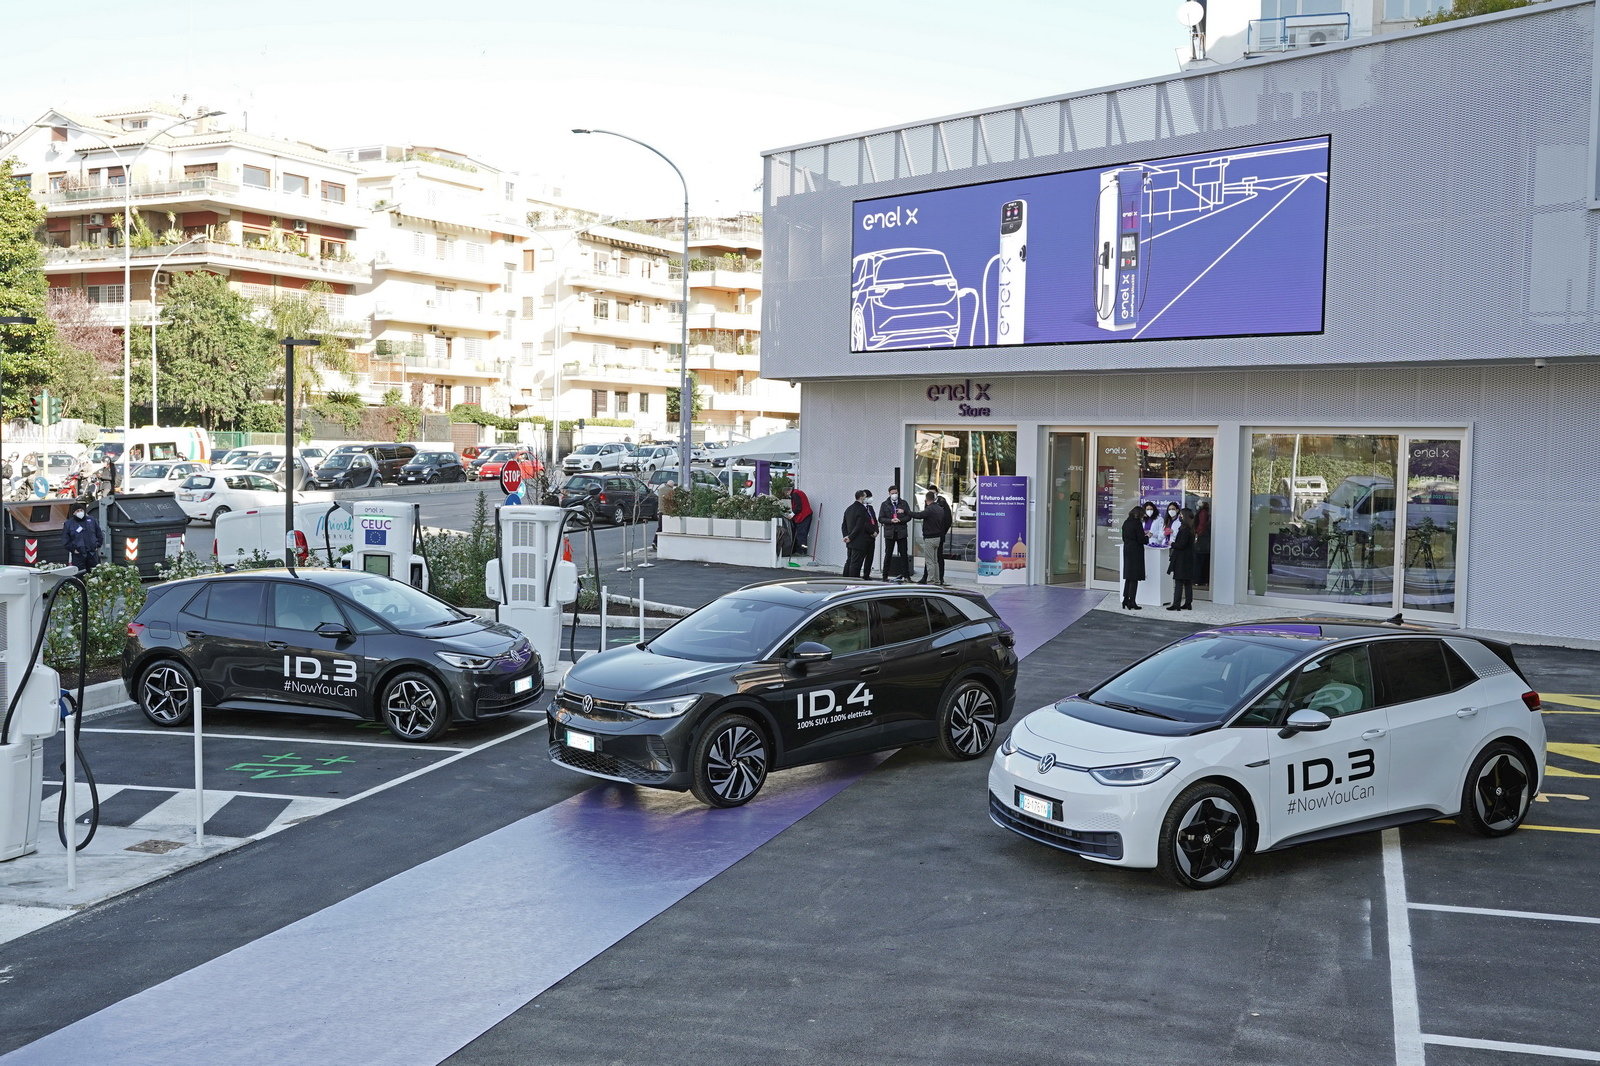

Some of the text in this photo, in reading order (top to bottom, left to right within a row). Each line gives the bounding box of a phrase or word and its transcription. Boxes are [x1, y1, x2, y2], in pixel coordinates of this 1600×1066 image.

[863, 206, 901, 230] enel
[1000, 281, 1011, 336] enel
[1120, 287, 1130, 319] enel
[926, 379, 971, 401] enel
[958, 403, 991, 417] Store
[1105, 446, 1120, 454] enel
[1413, 447, 1439, 458] enel
[504, 470, 521, 483] STOP
[361, 519, 392, 530] CEUC
[980, 540, 1000, 548] enel
[1272, 542, 1305, 557] enel
[284, 655, 357, 682] ID.3
[284, 680, 358, 697] #NowYouCan
[797, 682, 874, 720] ID.4
[797, 709, 873, 730] 100% SUV. 100% elettrica.
[1287, 748, 1375, 795] ID.3
[1287, 785, 1375, 815] #NowYouCan
